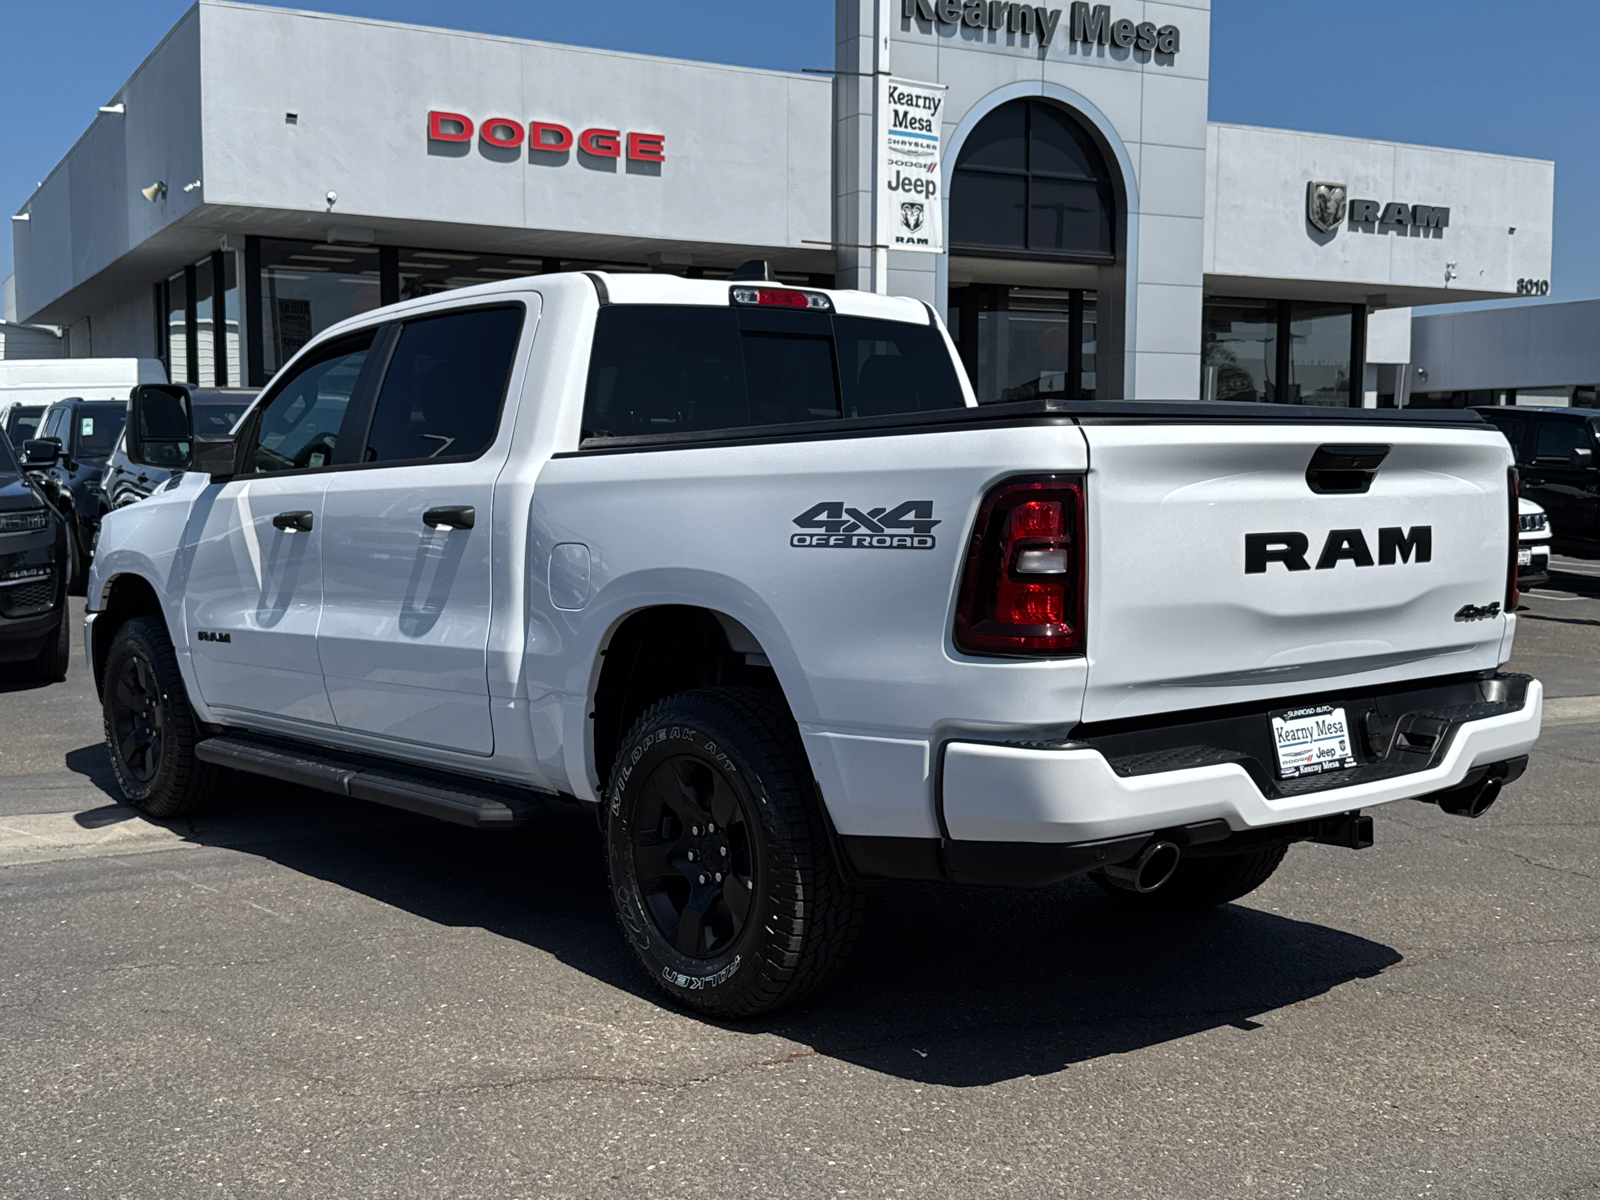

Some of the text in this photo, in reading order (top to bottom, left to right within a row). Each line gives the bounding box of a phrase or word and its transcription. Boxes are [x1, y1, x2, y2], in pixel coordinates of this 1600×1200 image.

[1070, 1, 1180, 54] Mesa
[888, 85, 942, 117] Kearny
[893, 109, 933, 133] Mesa
[428, 110, 665, 162] DODGE
[887, 170, 936, 200] Jeep
[1348, 199, 1451, 229] RAM
[895, 236, 929, 246] RAM
[1516, 277, 1549, 296] 8010
[792, 500, 942, 533] 4x4
[792, 535, 933, 547] OFF ROAD
[1244, 526, 1431, 575] RAM
[1454, 601, 1502, 622] 4x4
[198, 631, 231, 643] RAM
[1276, 720, 1344, 744] Kearny Mesa
[1315, 747, 1336, 759] Jeep
[611, 726, 697, 817] WILDPEAK
[1299, 764, 1322, 774] Kearny
[1322, 760, 1340, 770] Mesa
[662, 954, 742, 990] FALKEN
